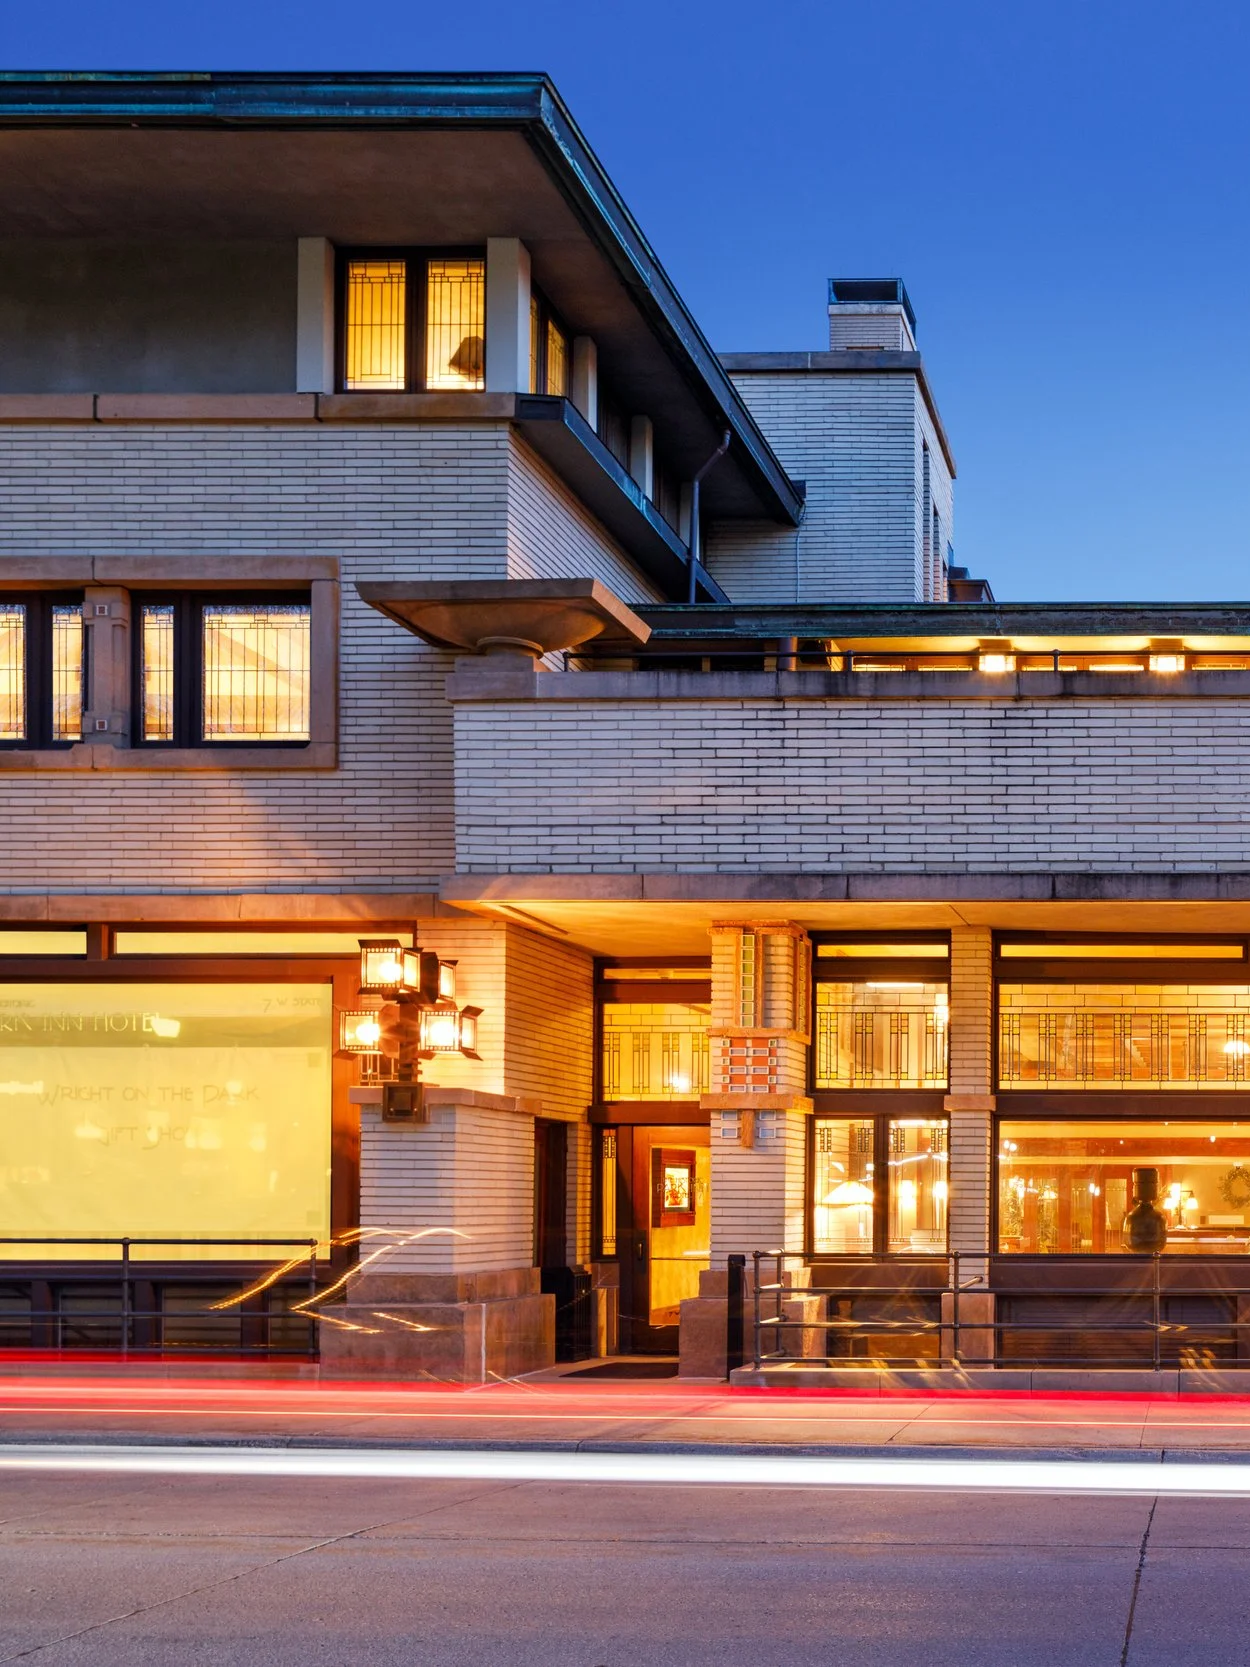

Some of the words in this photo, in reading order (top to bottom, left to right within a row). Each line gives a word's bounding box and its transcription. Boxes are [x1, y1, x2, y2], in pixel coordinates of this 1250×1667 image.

[43, 1010, 83, 1032] INN
[36, 1084, 115, 1107] WRIGHT
[121, 1086, 150, 1102] ON
[157, 1086, 194, 1102] THE
[141, 1125, 195, 1151] SHO
